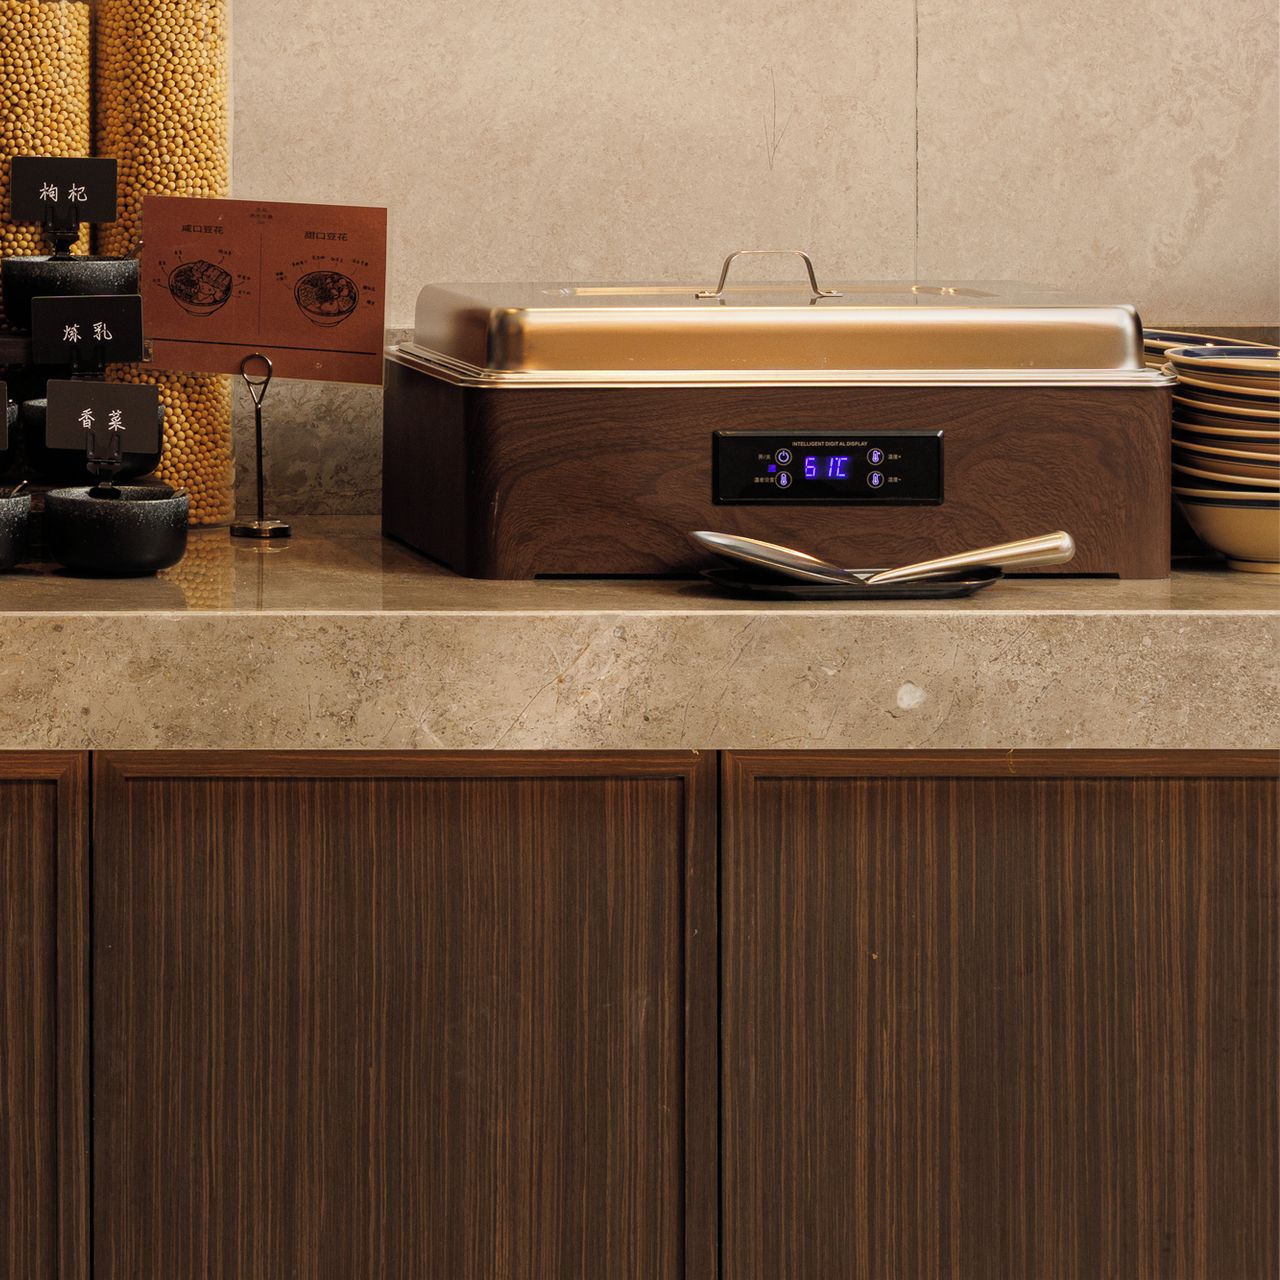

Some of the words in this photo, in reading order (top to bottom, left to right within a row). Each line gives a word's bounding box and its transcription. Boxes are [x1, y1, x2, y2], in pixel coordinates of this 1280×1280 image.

[39, 181, 88, 202] 枸杞
[62, 321, 113, 343] 炼乳
[78, 407, 126, 432] 香菜
